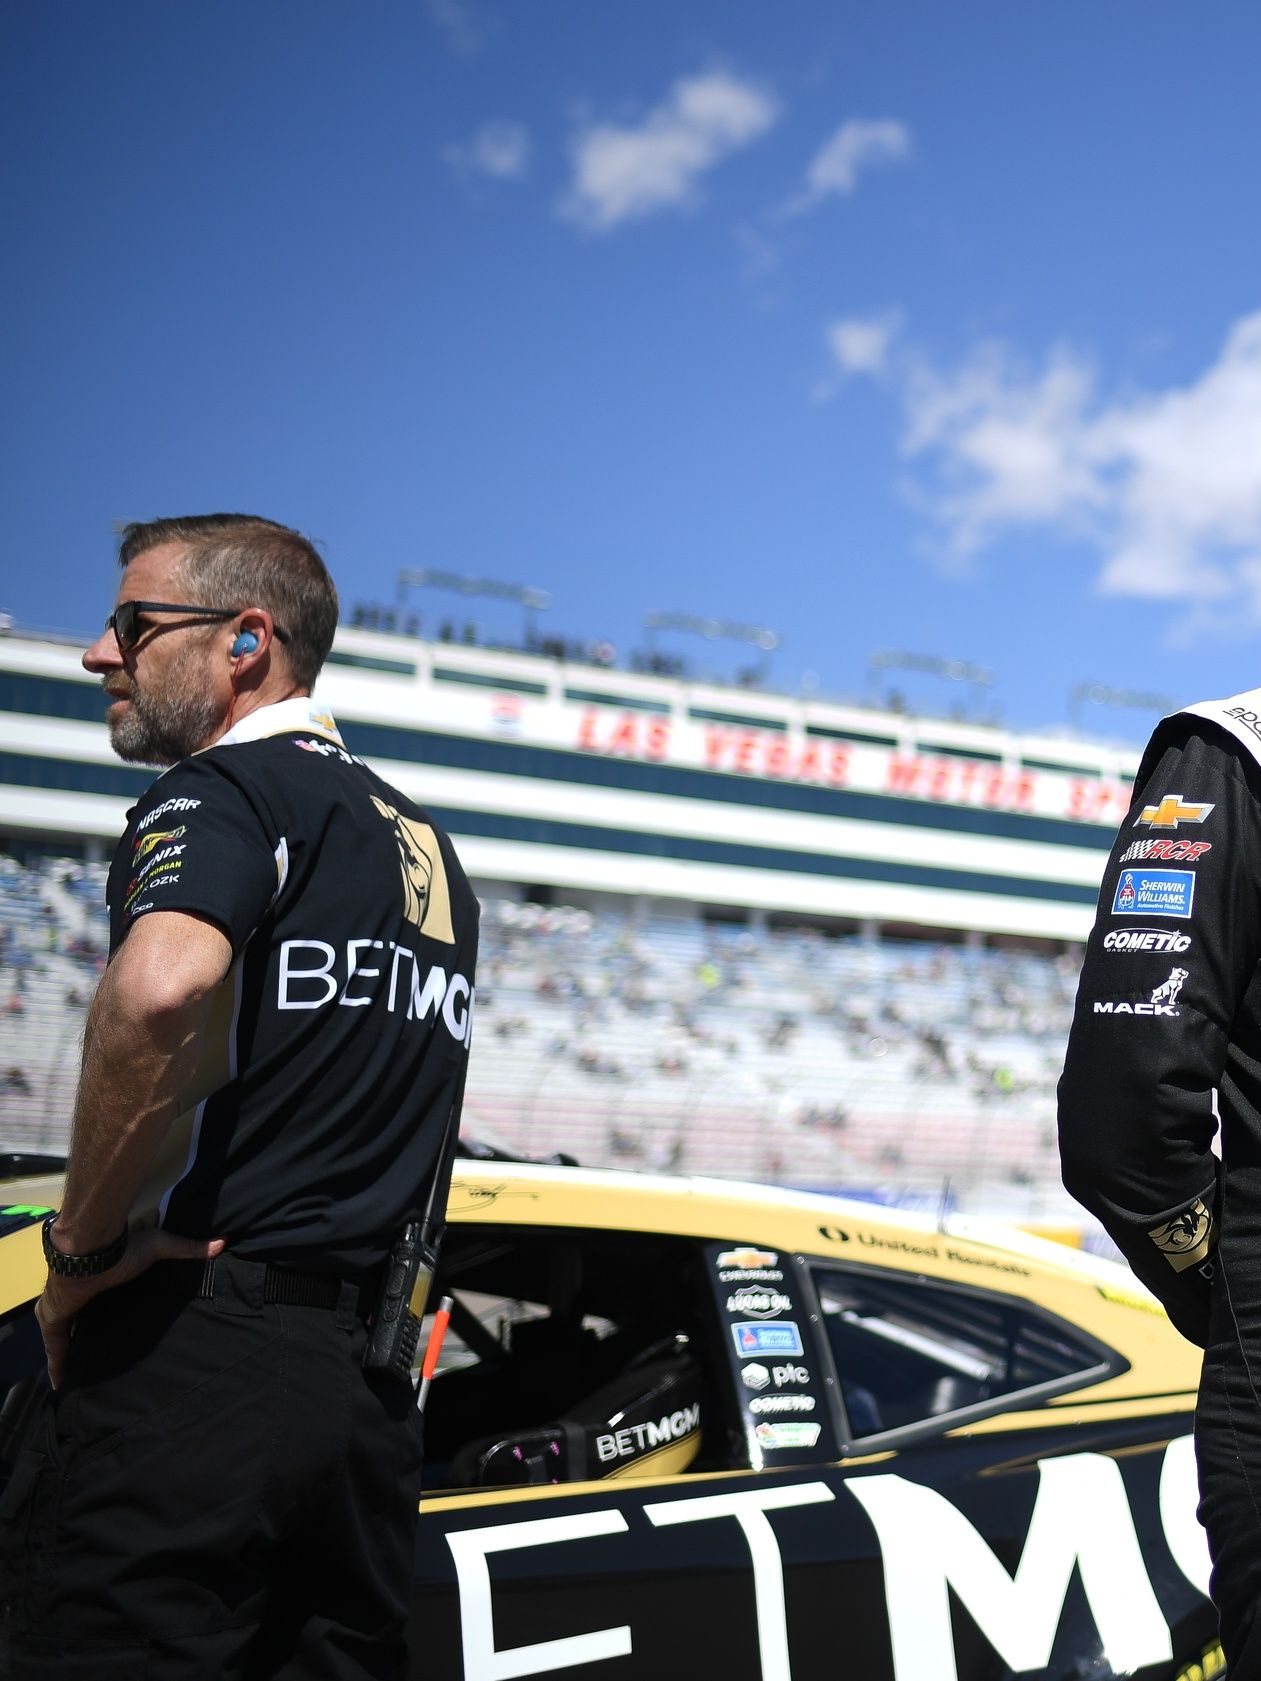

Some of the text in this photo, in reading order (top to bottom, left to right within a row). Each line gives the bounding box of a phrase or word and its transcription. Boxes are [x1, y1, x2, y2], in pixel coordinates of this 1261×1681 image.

[578, 703, 673, 763] LAS
[704, 719, 852, 789] VEGAS
[137, 798, 201, 833] NASCAR
[1143, 840, 1212, 861] RCR
[1139, 879, 1186, 893] SHERWIN
[1104, 931, 1191, 952] COMETIC
[277, 939, 475, 1050] BETMG
[1093, 1002, 1176, 1016] MACK
[596, 1402, 700, 1462] BETMGM
[445, 1433, 1213, 1681] ETM
